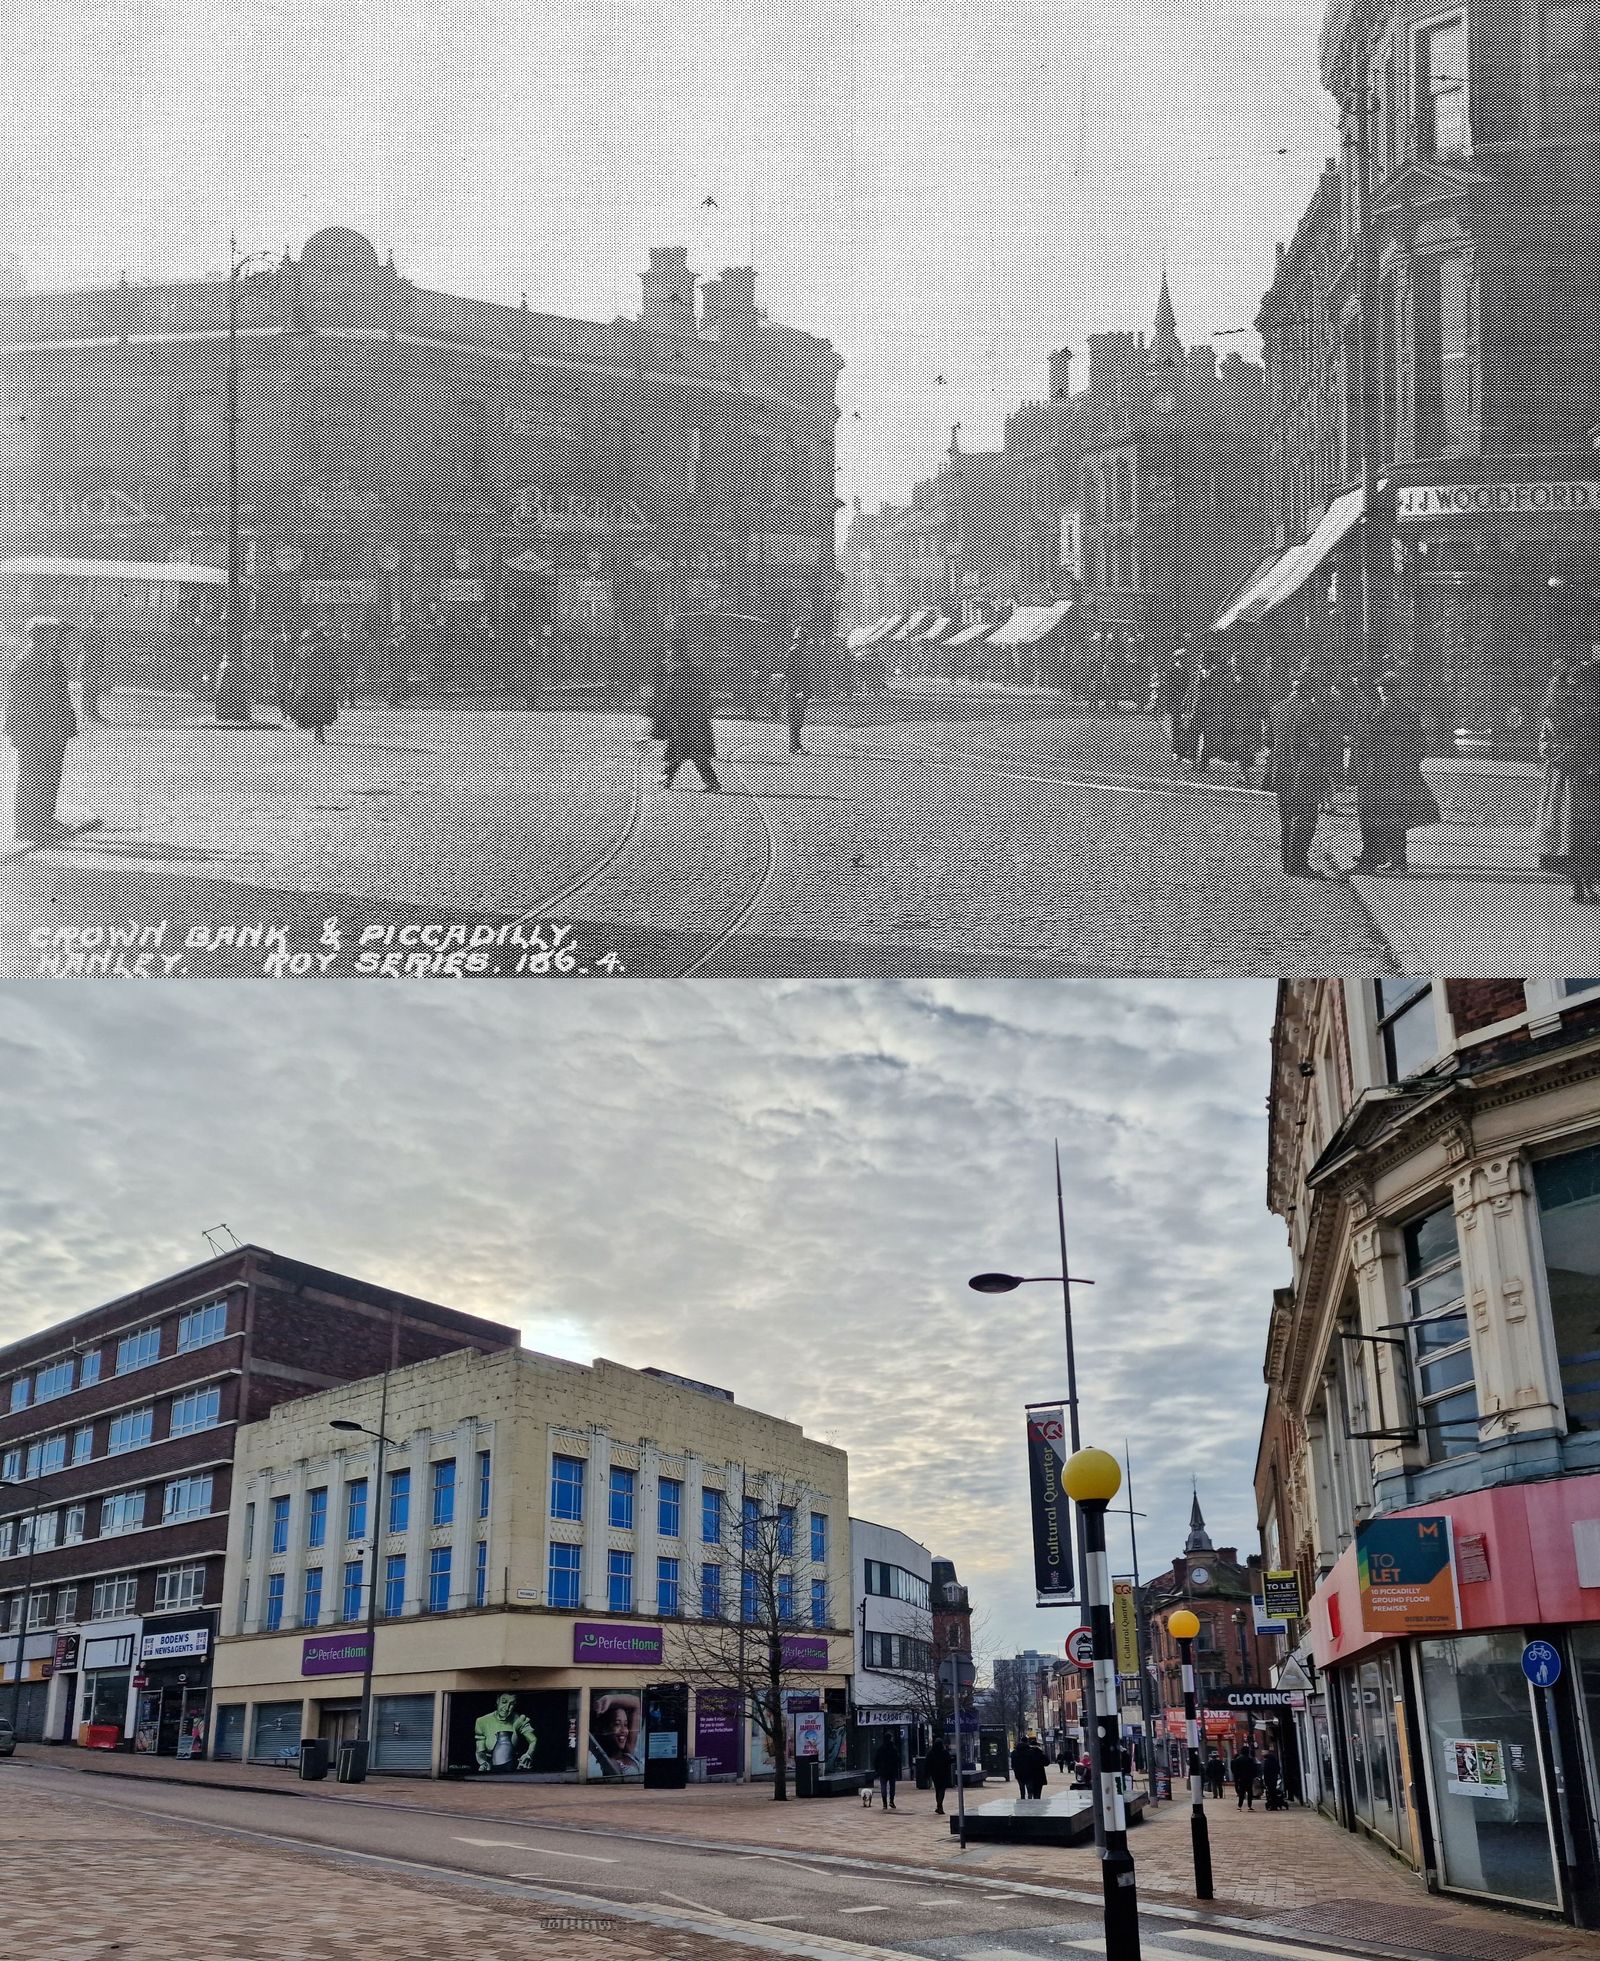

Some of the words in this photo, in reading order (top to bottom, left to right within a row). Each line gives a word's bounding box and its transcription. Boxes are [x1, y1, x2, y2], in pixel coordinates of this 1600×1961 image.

[1029, 1420, 1063, 1441] CQ
[1042, 1446, 1059, 1502] Quarter
[1046, 1503, 1061, 1566] Cultural
[1370, 1553, 1395, 1568] TO
[1371, 1568, 1402, 1582] LET
[1280, 1582, 1296, 1590] LET
[1379, 1587, 1421, 1595] PICCADILLY
[1121, 1597, 1131, 1628] Quarter
[160, 1633, 189, 1645] BODEN'S
[598, 1636, 660, 1651] PerfectHome
[1124, 1629, 1133, 1660] Cultural
[154, 1644, 194, 1655] NEWSAGENTS
[1228, 1693, 1291, 1706] CLOTHING
